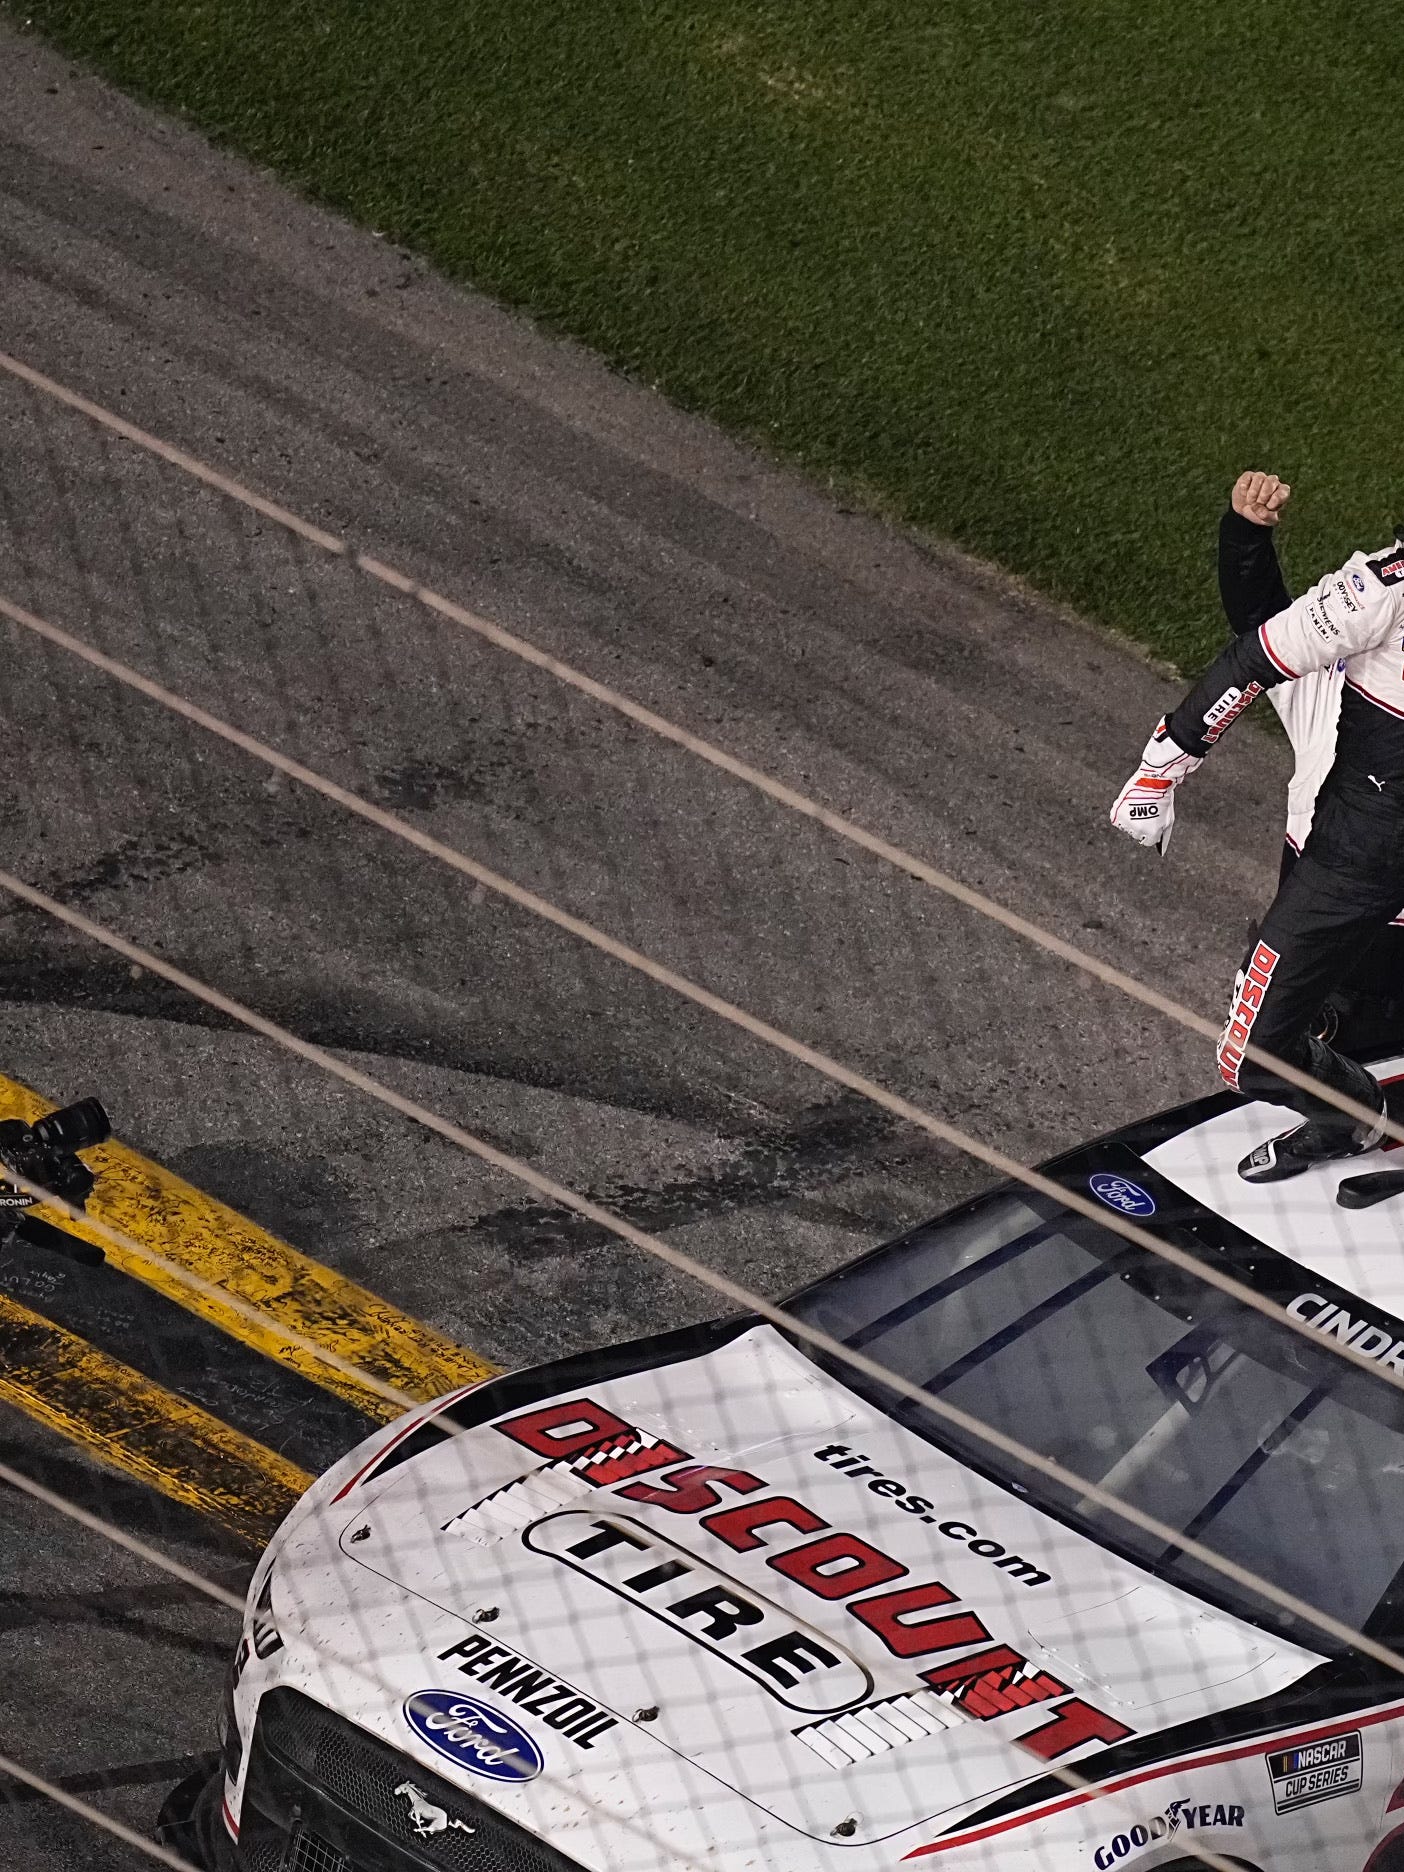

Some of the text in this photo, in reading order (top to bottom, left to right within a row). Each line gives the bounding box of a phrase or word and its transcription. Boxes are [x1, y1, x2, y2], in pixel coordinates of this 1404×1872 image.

[1207, 693, 1238, 722] TIRE
[1129, 804, 1160, 818] OMP
[1219, 940, 1281, 1091] DISCOUN
[1099, 1175, 1137, 1212] Ford
[813, 1444, 1052, 1588] tires.com
[489, 1397, 1138, 1764] DISCOUNT
[557, 1520, 842, 1690] TIRE
[437, 1633, 620, 1750] PENNZOIL
[423, 1702, 521, 1769] Ford
[1297, 1740, 1347, 1769] NASCAR
[1285, 1764, 1349, 1798] CUP SERIES
[1094, 1804, 1245, 1871] GOODYEAR
